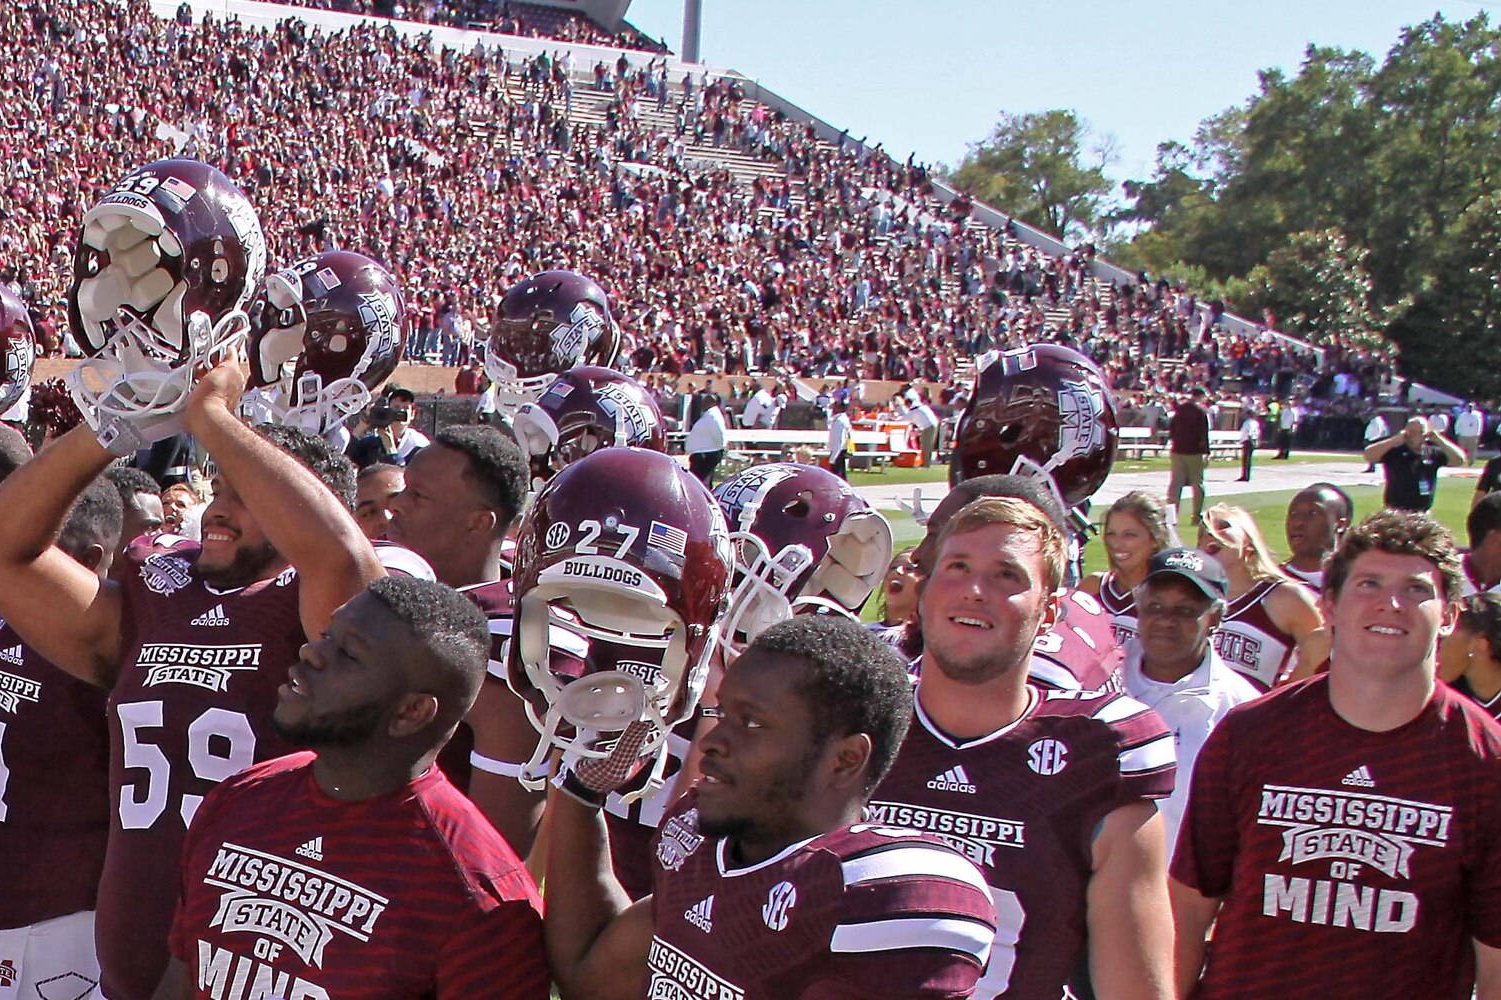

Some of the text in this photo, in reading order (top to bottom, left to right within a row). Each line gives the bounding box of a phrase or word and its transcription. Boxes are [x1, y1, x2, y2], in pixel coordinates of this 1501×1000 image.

[374, 304, 391, 347] STATE
[564, 318, 592, 350] STATE
[614, 391, 646, 430] STATE
[1077, 395, 1090, 442] STATE
[548, 524, 569, 547] SEC
[575, 519, 640, 559] 27
[149, 573, 167, 590] 100
[563, 561, 642, 586] BULLDOGS
[190, 617, 230, 627] adidas
[136, 647, 262, 666] MISSISSIPPI
[156, 669, 215, 687] STATE
[116, 700, 257, 830] 59
[1027, 738, 1069, 776] SEC
[926, 779, 976, 794] adidas
[1342, 778, 1376, 788] adidas
[868, 804, 1024, 843] MISSISSIPPI
[1258, 790, 1453, 840] MISSISSIPPI
[295, 848, 324, 862] adidas
[1304, 833, 1387, 866] STATE
[1330, 861, 1363, 880] OF
[207, 849, 386, 935] MISSISSIPPI
[761, 880, 797, 931] SEC
[1262, 873, 1420, 933] MIND
[235, 904, 311, 949] STATE
[684, 909, 713, 934] adidas
[253, 937, 284, 963] OF
